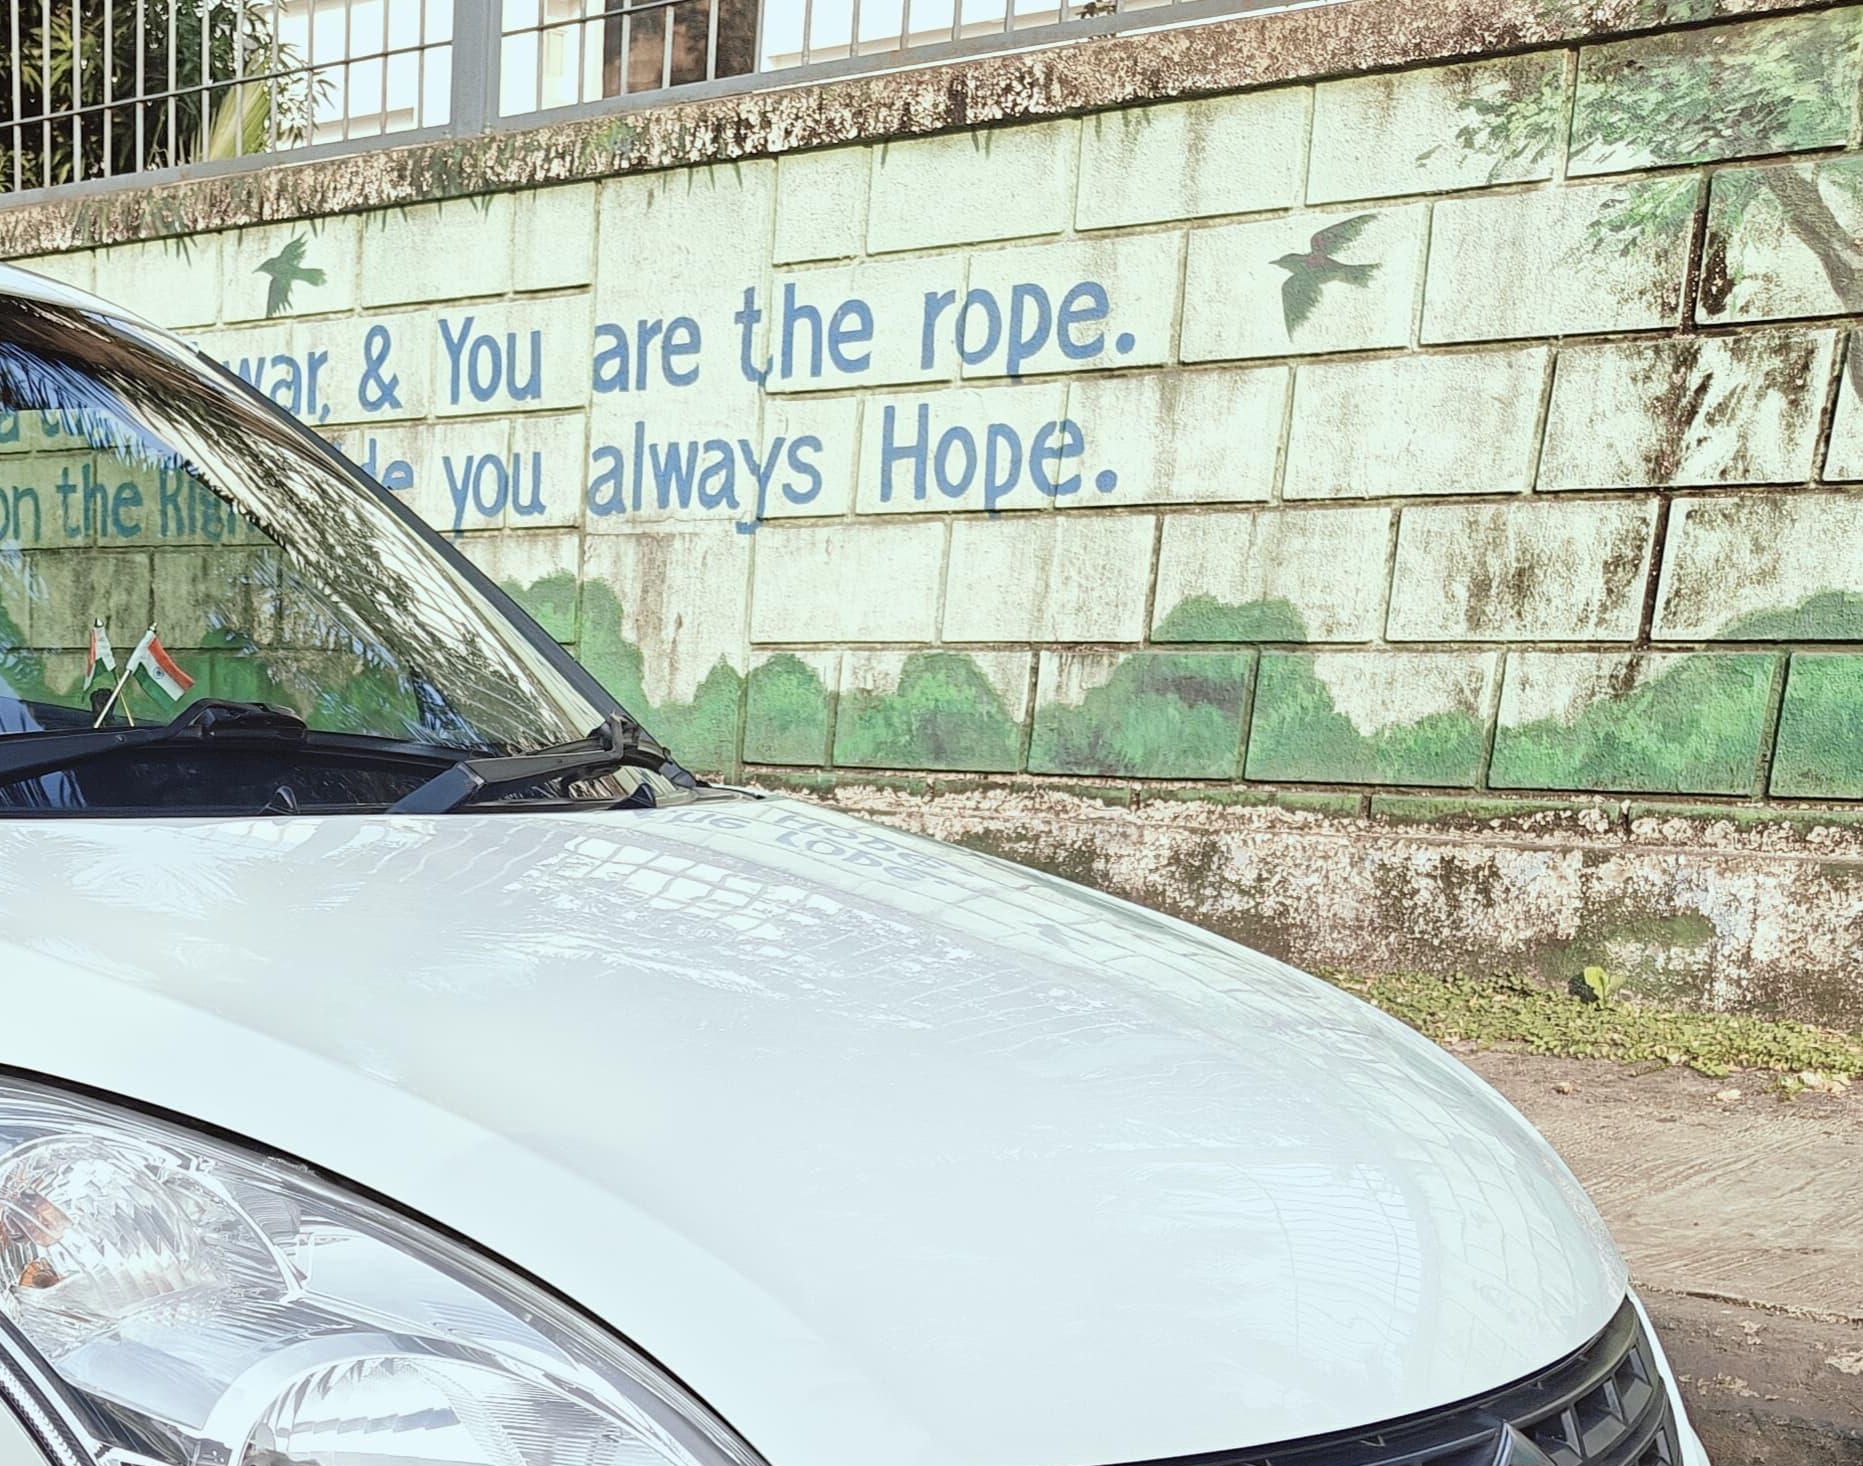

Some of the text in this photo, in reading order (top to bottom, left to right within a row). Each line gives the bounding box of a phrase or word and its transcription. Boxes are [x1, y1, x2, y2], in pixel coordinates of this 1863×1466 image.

[358, 325, 402, 412] &
[438, 316, 542, 405] You
[592, 316, 702, 393] are
[734, 282, 874, 386] the
[920, 281, 1135, 384] rope.
[56, 467, 143, 538] the
[442, 451, 547, 546] you
[588, 420, 823, 535] always
[880, 403, 1118, 520] Hope.
